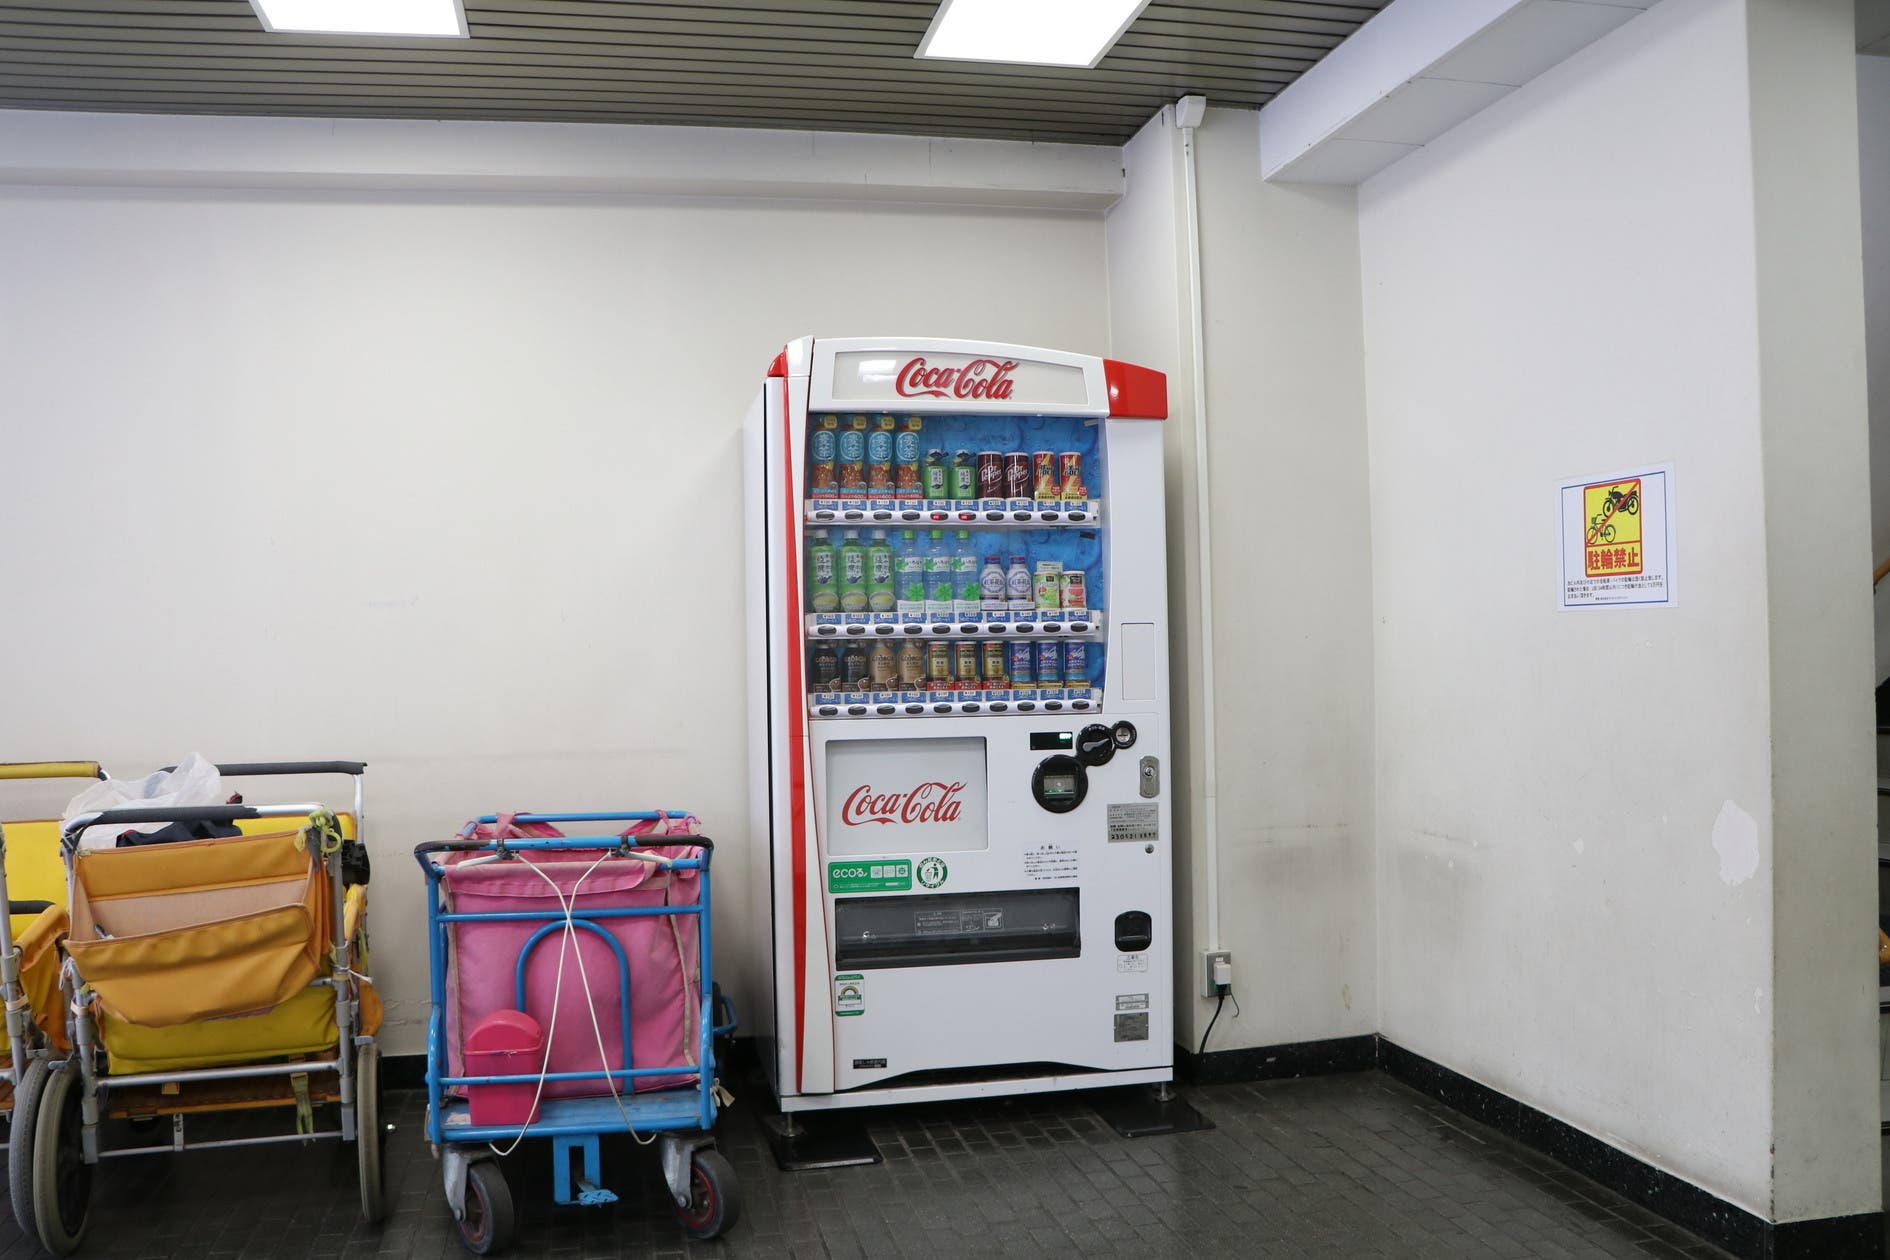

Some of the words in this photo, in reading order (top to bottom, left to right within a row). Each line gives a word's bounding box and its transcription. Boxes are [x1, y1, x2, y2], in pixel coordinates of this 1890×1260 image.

[896, 357, 1019, 400] Coca-Cola
[1588, 547, 1640, 571] 駐輪禁止
[842, 781, 967, 826] Coca-Cola
